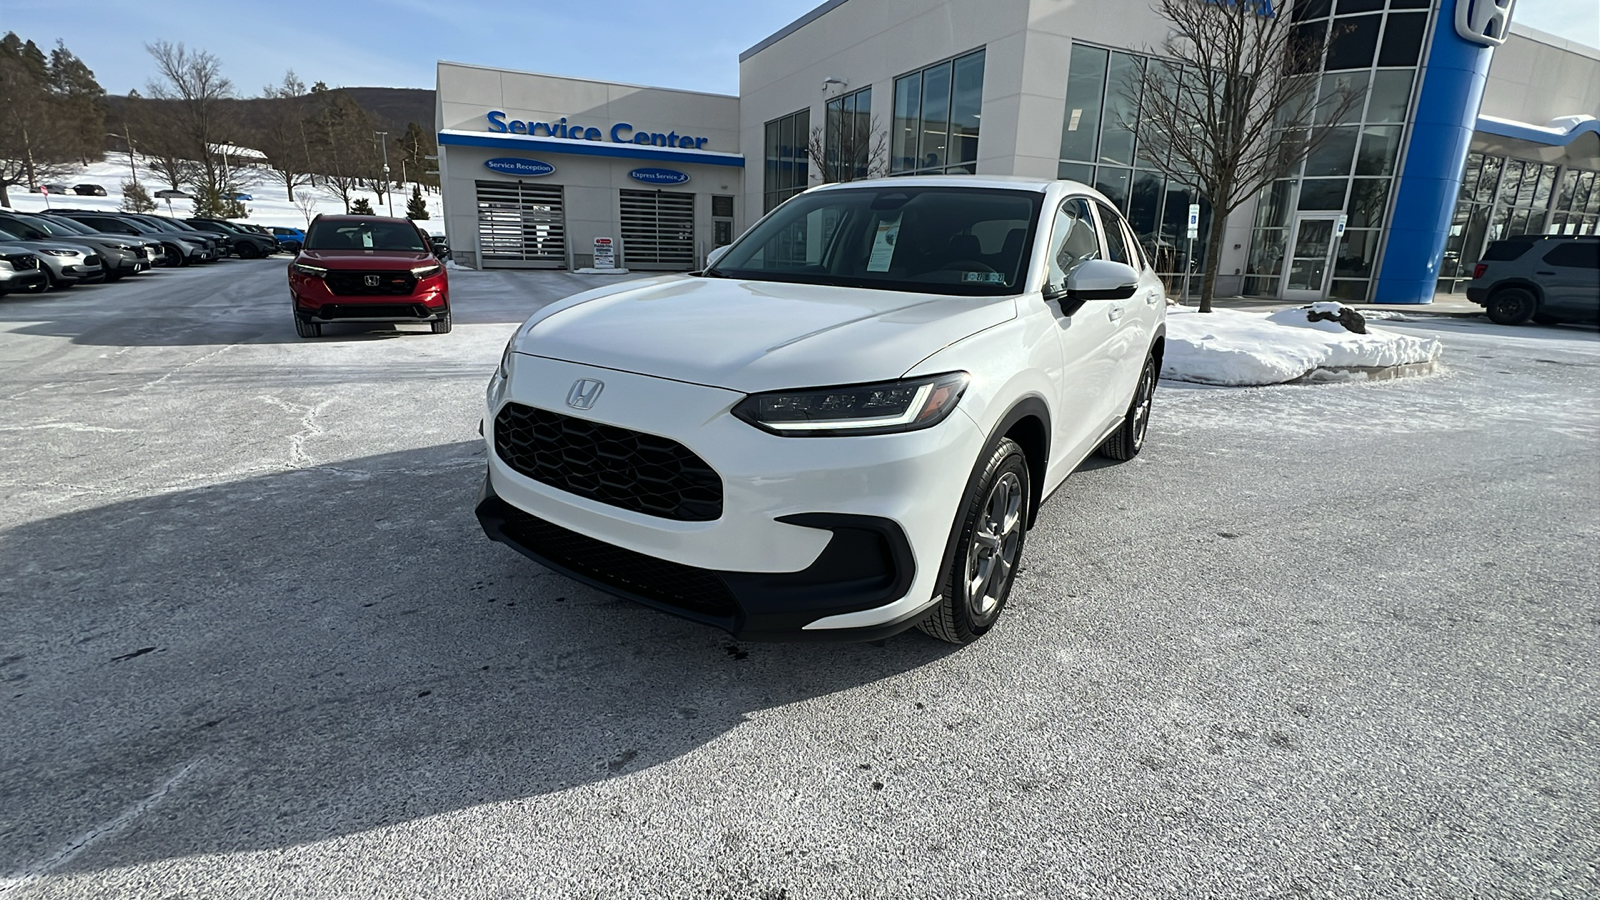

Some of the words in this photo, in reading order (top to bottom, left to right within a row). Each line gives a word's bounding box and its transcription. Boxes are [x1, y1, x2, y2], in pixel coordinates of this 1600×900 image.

[486, 110, 602, 142] Service
[610, 122, 709, 150] Center
[488, 160, 515, 169] Service
[516, 162, 551, 172] Reception
[632, 171, 655, 179] Express
[655, 172, 678, 180] Service
